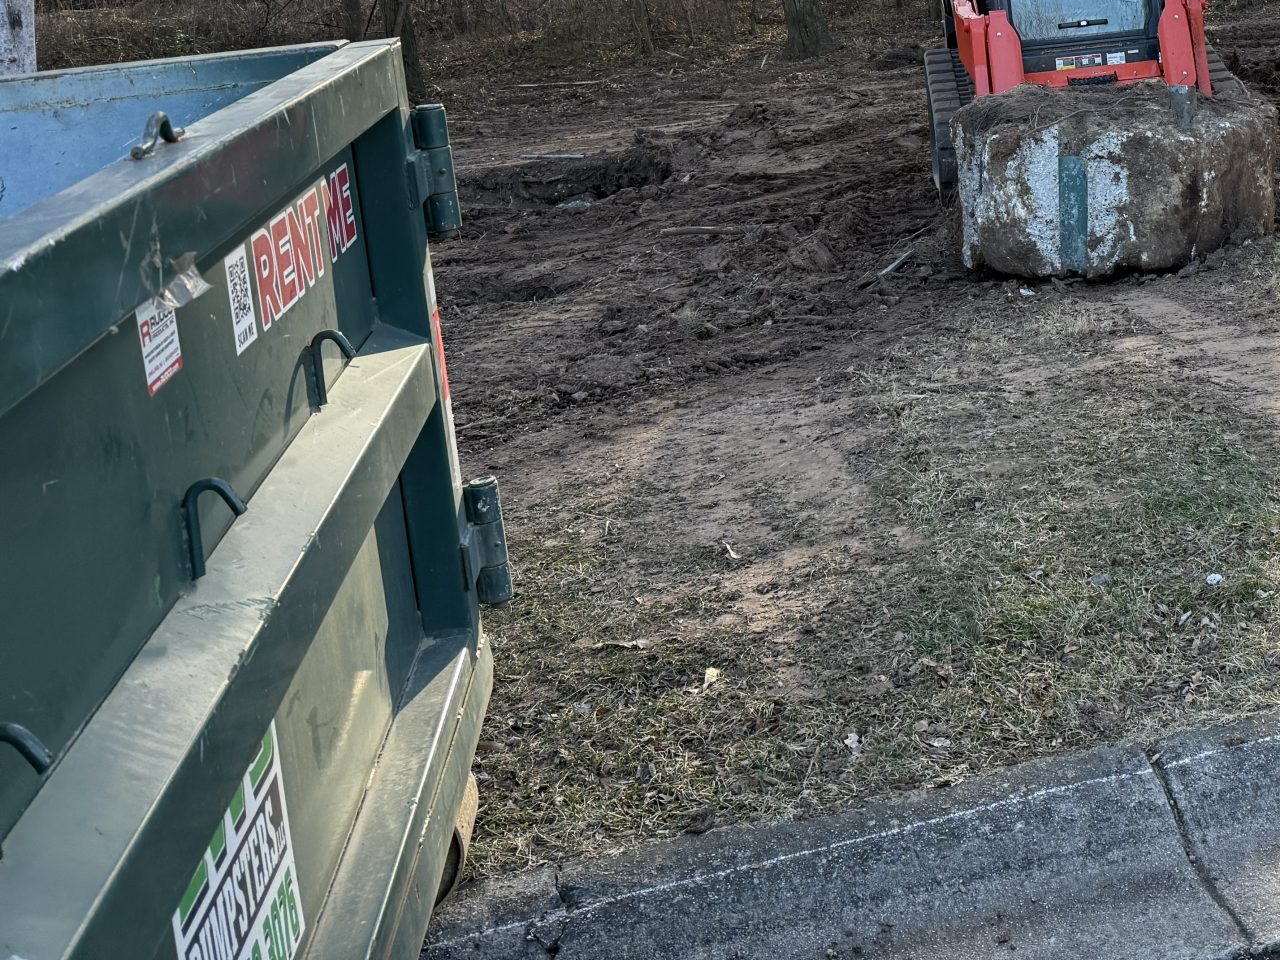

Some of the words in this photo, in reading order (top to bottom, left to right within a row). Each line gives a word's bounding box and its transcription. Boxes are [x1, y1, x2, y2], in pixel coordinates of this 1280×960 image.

[251, 187, 325, 332] RENT
[321, 162, 358, 264] ME
[238, 327, 248, 348] SCAN
[248, 321, 254, 338] ME
[188, 795, 278, 960] MPSTERS
[275, 821, 286, 854] LLC
